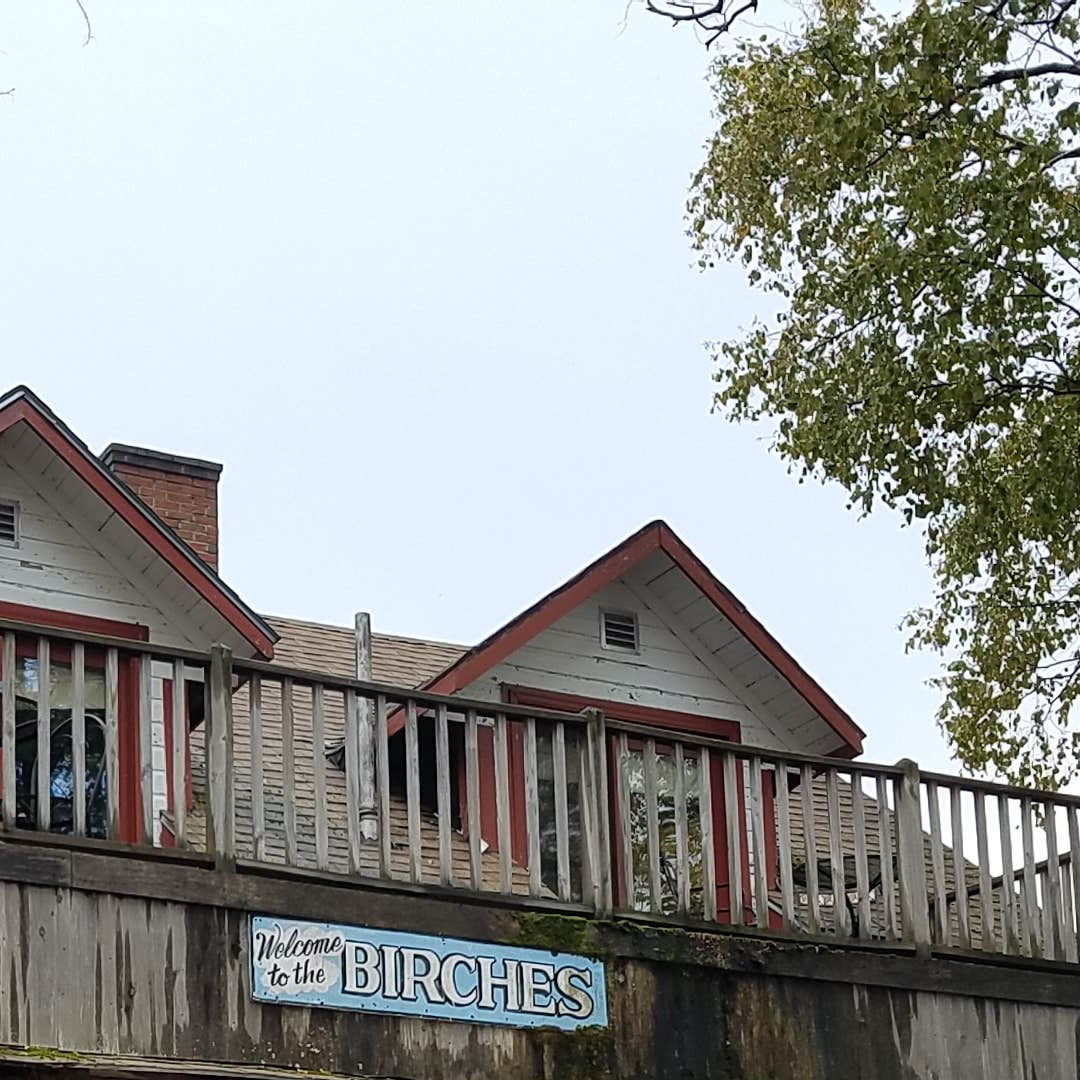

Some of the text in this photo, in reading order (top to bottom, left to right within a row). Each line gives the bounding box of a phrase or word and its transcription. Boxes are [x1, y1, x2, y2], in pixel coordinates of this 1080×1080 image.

[256, 923, 343, 961] Welcome
[267, 958, 326, 986] to the
[342, 940, 595, 1020] BIRCHES
